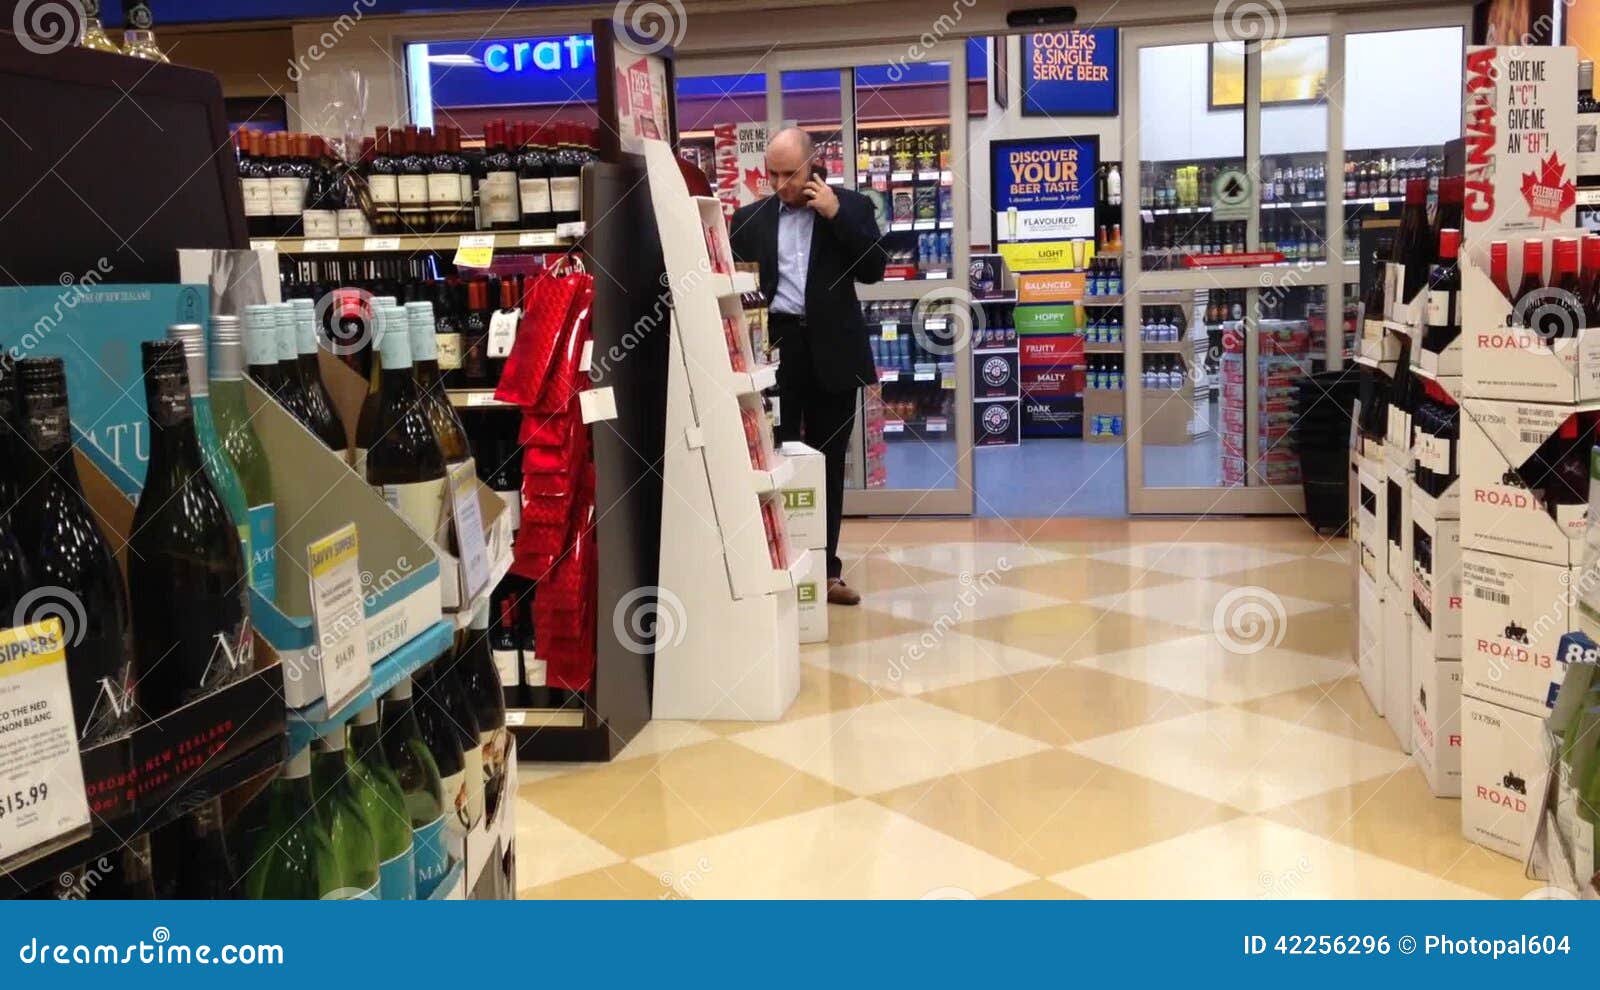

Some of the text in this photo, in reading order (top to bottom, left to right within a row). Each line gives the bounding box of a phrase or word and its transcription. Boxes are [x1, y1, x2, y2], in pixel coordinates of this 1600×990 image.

[1032, 32, 1096, 49] COOLERS
[484, 35, 596, 73] craf
[1033, 50, 1093, 65] & SINGLE
[1032, 65, 1109, 81] SERVE BEER
[1508, 60, 1546, 81] GIVE ME
[1508, 85, 1516, 105] A
[1508, 108, 1545, 130] GIVE ME
[739, 128, 766, 141] GIVE ME
[1464, 46, 1497, 223] CANADA
[740, 141, 766, 153] GIVE ME
[1507, 132, 1521, 154] AN
[1009, 149, 1078, 164] DISCOVER
[1010, 162, 1078, 183] YOUR
[1010, 181, 1079, 195] BEER TASTE
[1024, 216, 1076, 226] FLAVOURED
[1038, 250, 1064, 258] LIGHT
[1024, 280, 1072, 290] BALANCED
[1035, 312, 1065, 321] HOPPY
[1026, 344, 1056, 353] FRUITY
[1477, 335, 1531, 349] ROAD
[1037, 373, 1066, 382] MALTY
[1027, 404, 1051, 414] DARK
[1474, 489, 1527, 508] ROAD
[1477, 639, 1552, 669] ROAD 13
[11, 704, 28, 718] THE
[29, 699, 48, 713] NED
[23, 710, 53, 728] BLANC
[1476, 785, 1527, 813] ROAD
